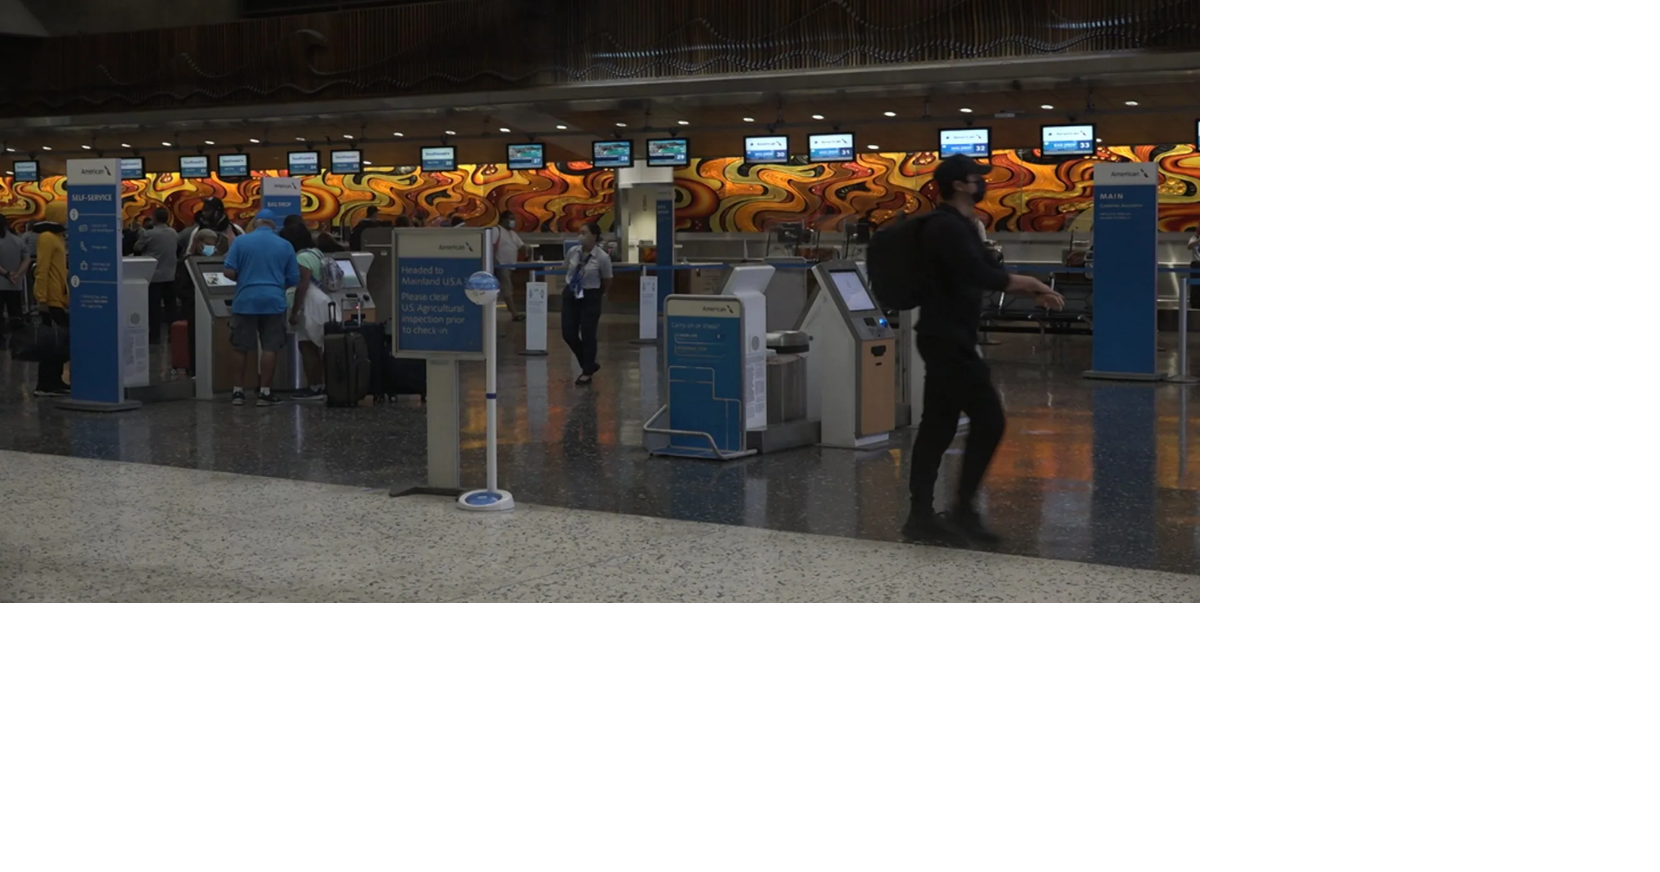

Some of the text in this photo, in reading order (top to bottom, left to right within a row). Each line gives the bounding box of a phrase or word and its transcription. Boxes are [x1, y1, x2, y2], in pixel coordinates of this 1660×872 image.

[71, 193, 112, 201] SELF-SERVICE
[401, 266, 444, 275] Headed to
[401, 277, 440, 286] Mainland
[401, 292, 449, 301] Please clear
[417, 304, 465, 315] Agricultural
[402, 315, 465, 326] inspection prior
[402, 326, 412, 334] to
